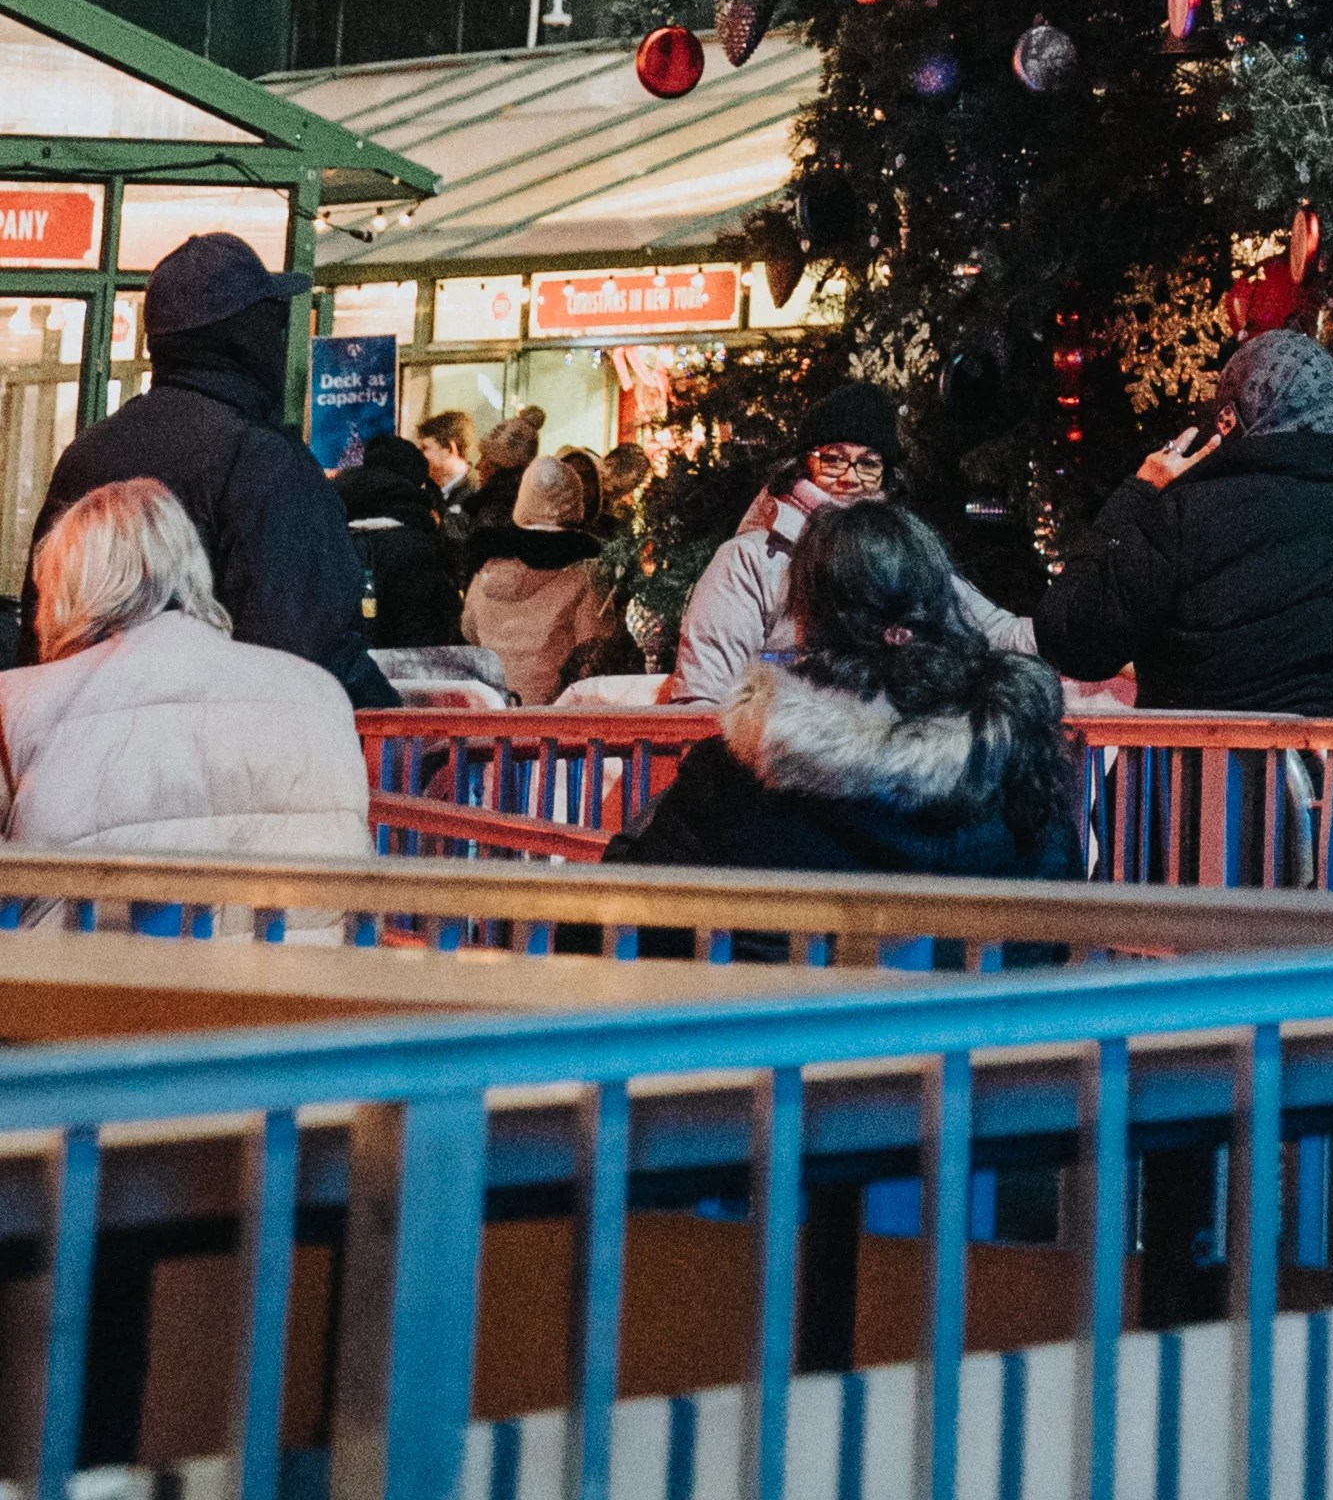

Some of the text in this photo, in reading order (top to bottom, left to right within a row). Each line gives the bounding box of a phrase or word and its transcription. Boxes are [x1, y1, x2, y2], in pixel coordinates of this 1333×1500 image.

[320, 372, 386, 389] Deck at
[317, 388, 389, 409] capacity
